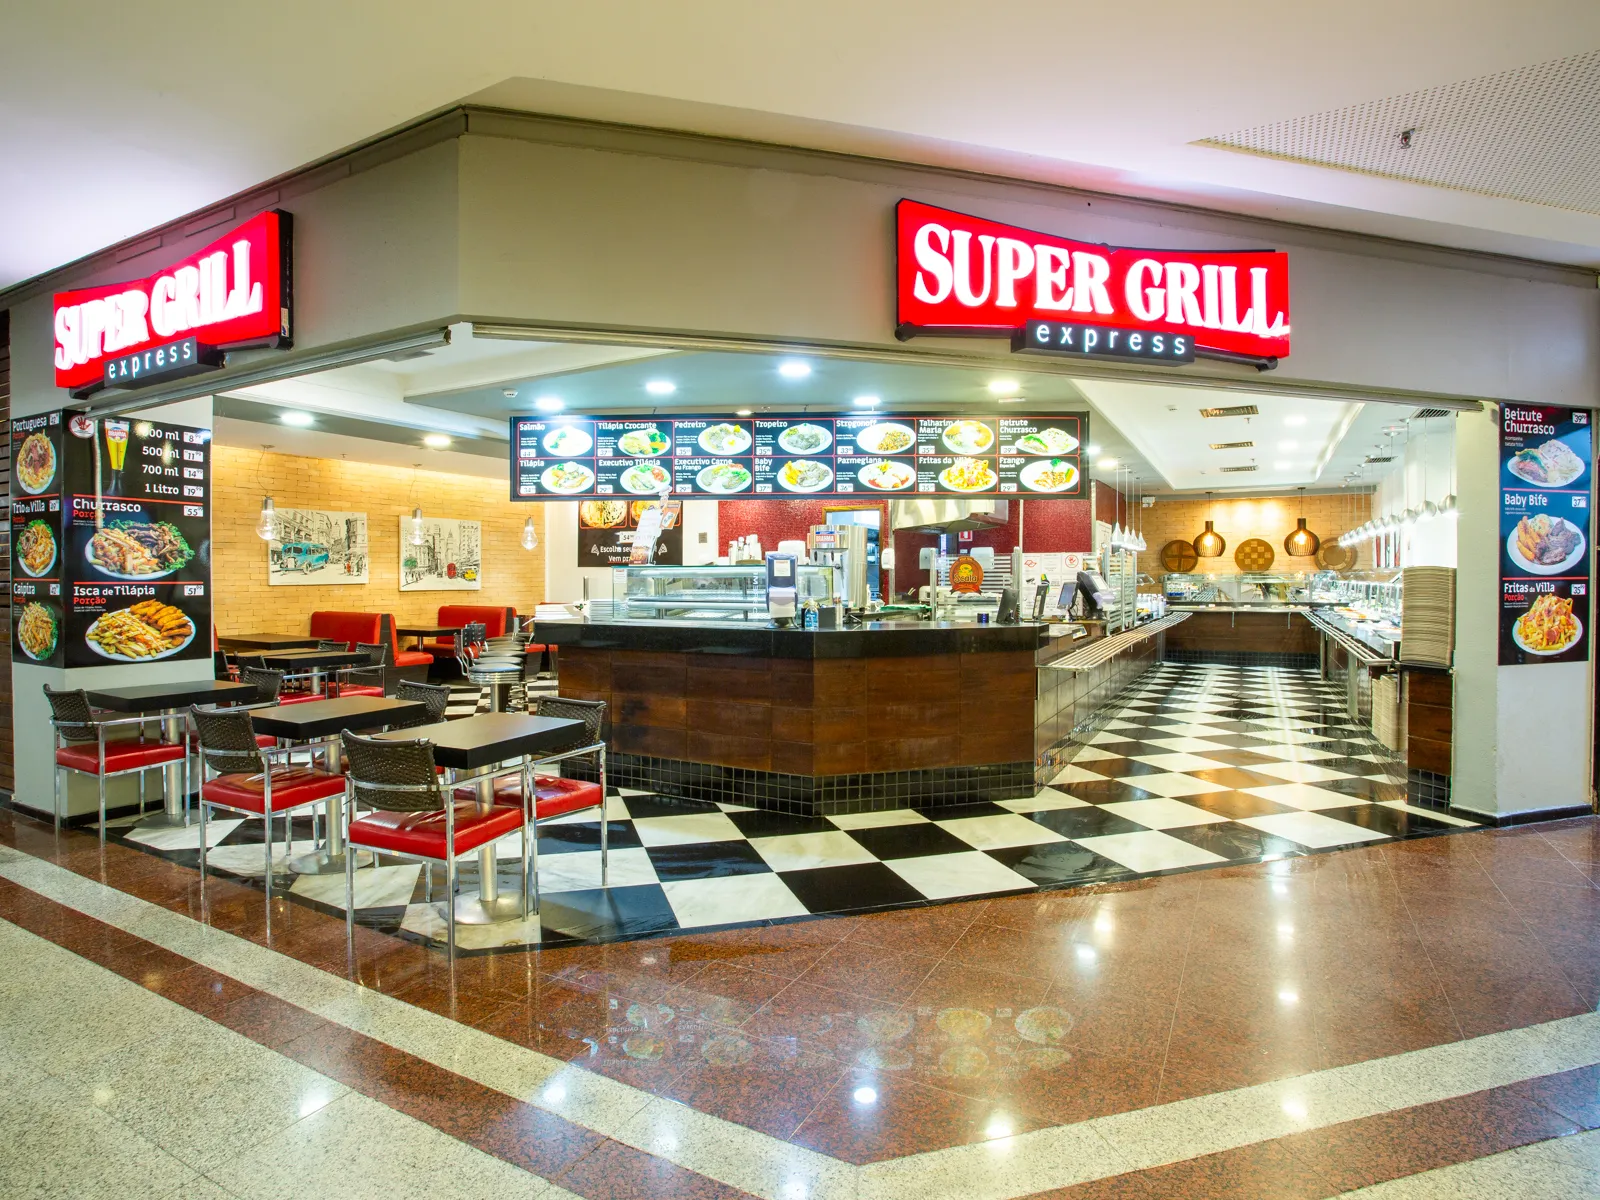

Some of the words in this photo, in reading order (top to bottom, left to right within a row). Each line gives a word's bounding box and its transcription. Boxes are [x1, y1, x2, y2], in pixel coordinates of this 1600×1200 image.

[914, 223, 1116, 315] SUPER
[1125, 258, 1286, 338] GRILL
[54, 290, 151, 370] SUPER
[150, 240, 264, 337] GRILL
[1036, 323, 1187, 355] express
[108, 342, 192, 378] express
[1504, 408, 1543, 422] Beirute
[13, 417, 47, 432] Portuguesa
[598, 422, 624, 431] Tilápia
[624, 422, 657, 430] Crocante
[755, 421, 788, 429] Tropeiro
[1504, 420, 1555, 435] Churrasco
[165, 430, 180, 441] ml
[142, 446, 163, 456] 500
[519, 460, 545, 468] Tilápia
[755, 458, 773, 466] Baby
[837, 457, 882, 465] Parmegiana
[999, 458, 1025, 466] Frango
[142, 465, 162, 475] 700
[164, 467, 180, 476] ml
[145, 483, 151, 492] 1
[153, 484, 180, 495] Litro
[73, 498, 142, 513] Churrasco
[1504, 494, 1527, 508] Baby
[1529, 494, 1548, 506] Bife
[12, 502, 25, 514] Trio
[30, 500, 46, 513] Villa
[13, 583, 36, 596] Caipira
[73, 586, 99, 596] Isca
[114, 586, 155, 597] Tilápia
[1504, 583, 1529, 593] Fritas
[1535, 582, 1556, 592] Villa
[73, 596, 107, 606] Porção
